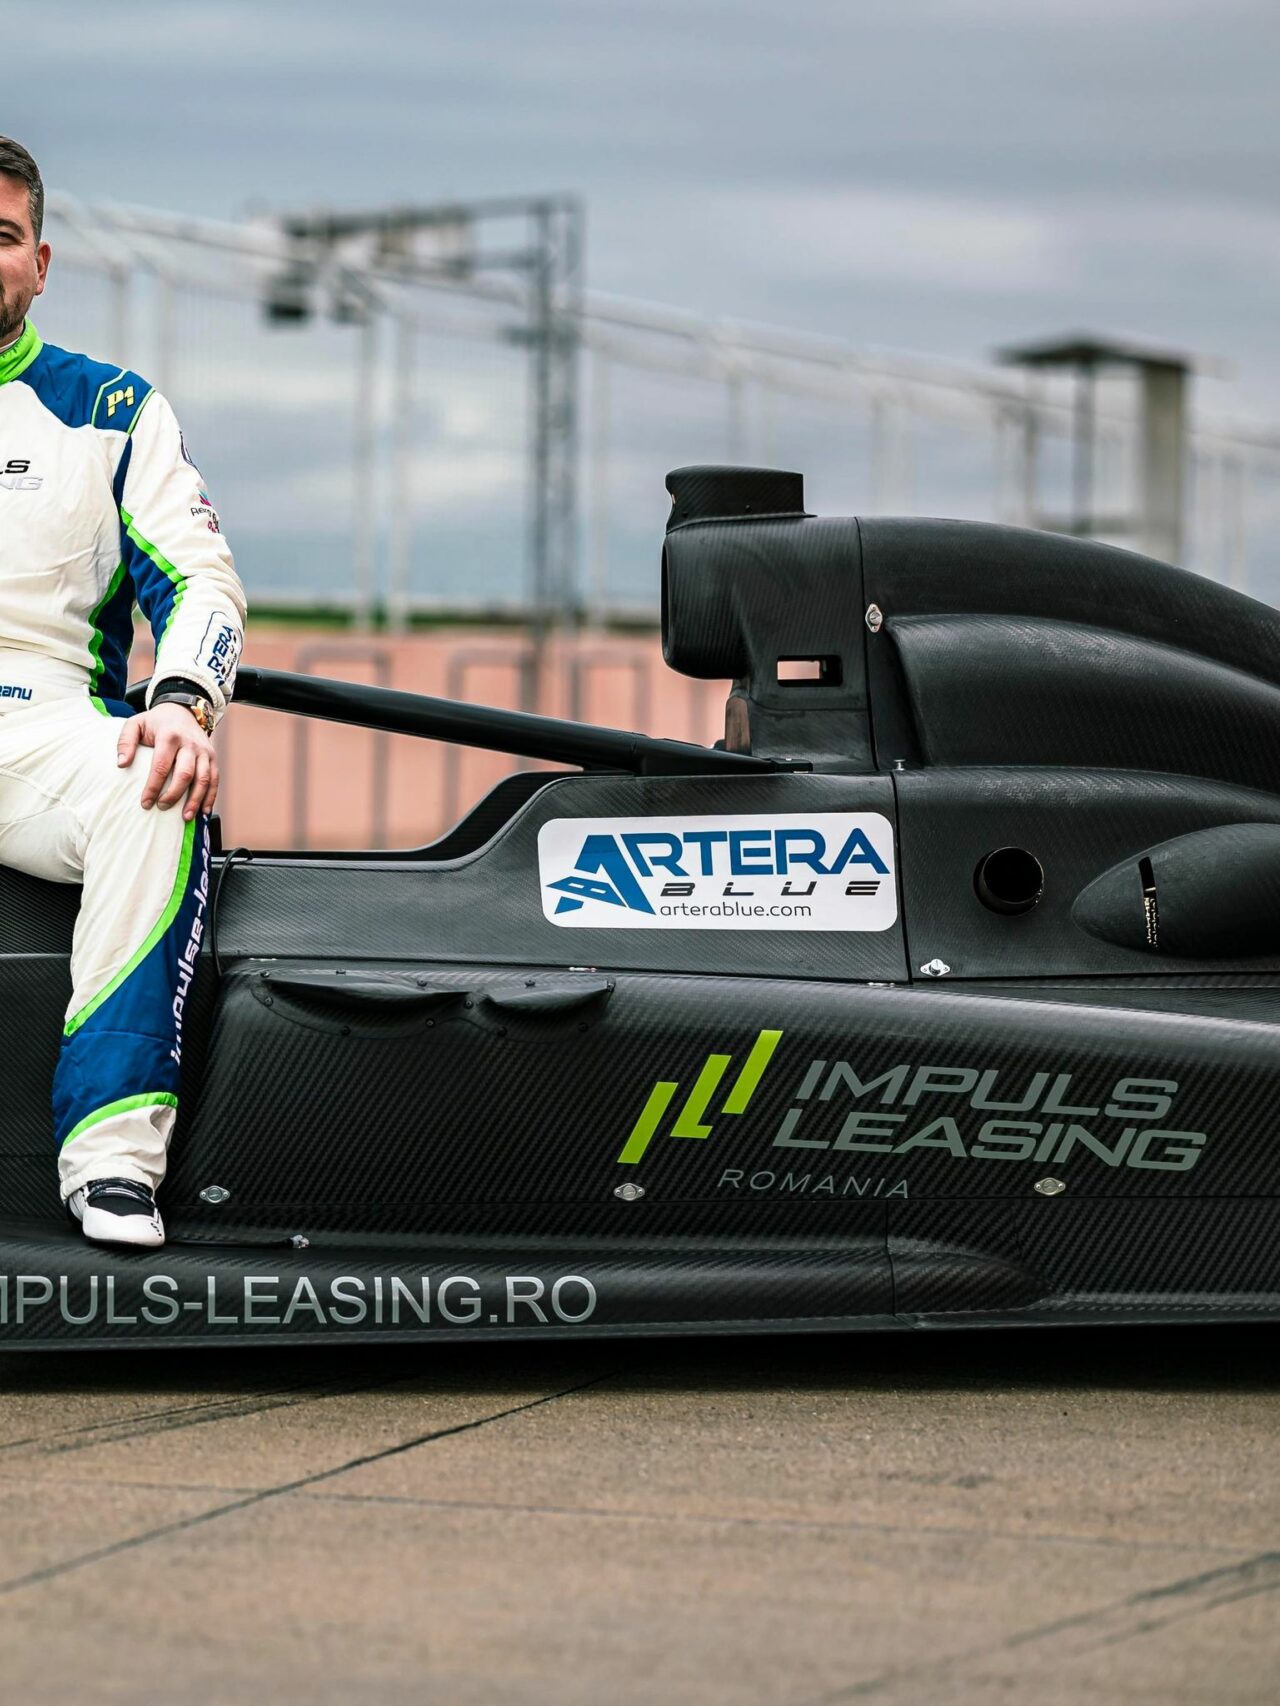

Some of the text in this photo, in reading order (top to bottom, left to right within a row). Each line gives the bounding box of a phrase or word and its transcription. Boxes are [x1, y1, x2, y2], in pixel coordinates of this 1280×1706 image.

[546, 827, 891, 916] ARTERA
[659, 880, 882, 897] BLUE
[659, 901, 812, 918] arterablue.com
[795, 1059, 1179, 1120] IMPULS
[772, 1108, 1208, 1172] LEASING
[716, 1168, 910, 1200] ROMANIA
